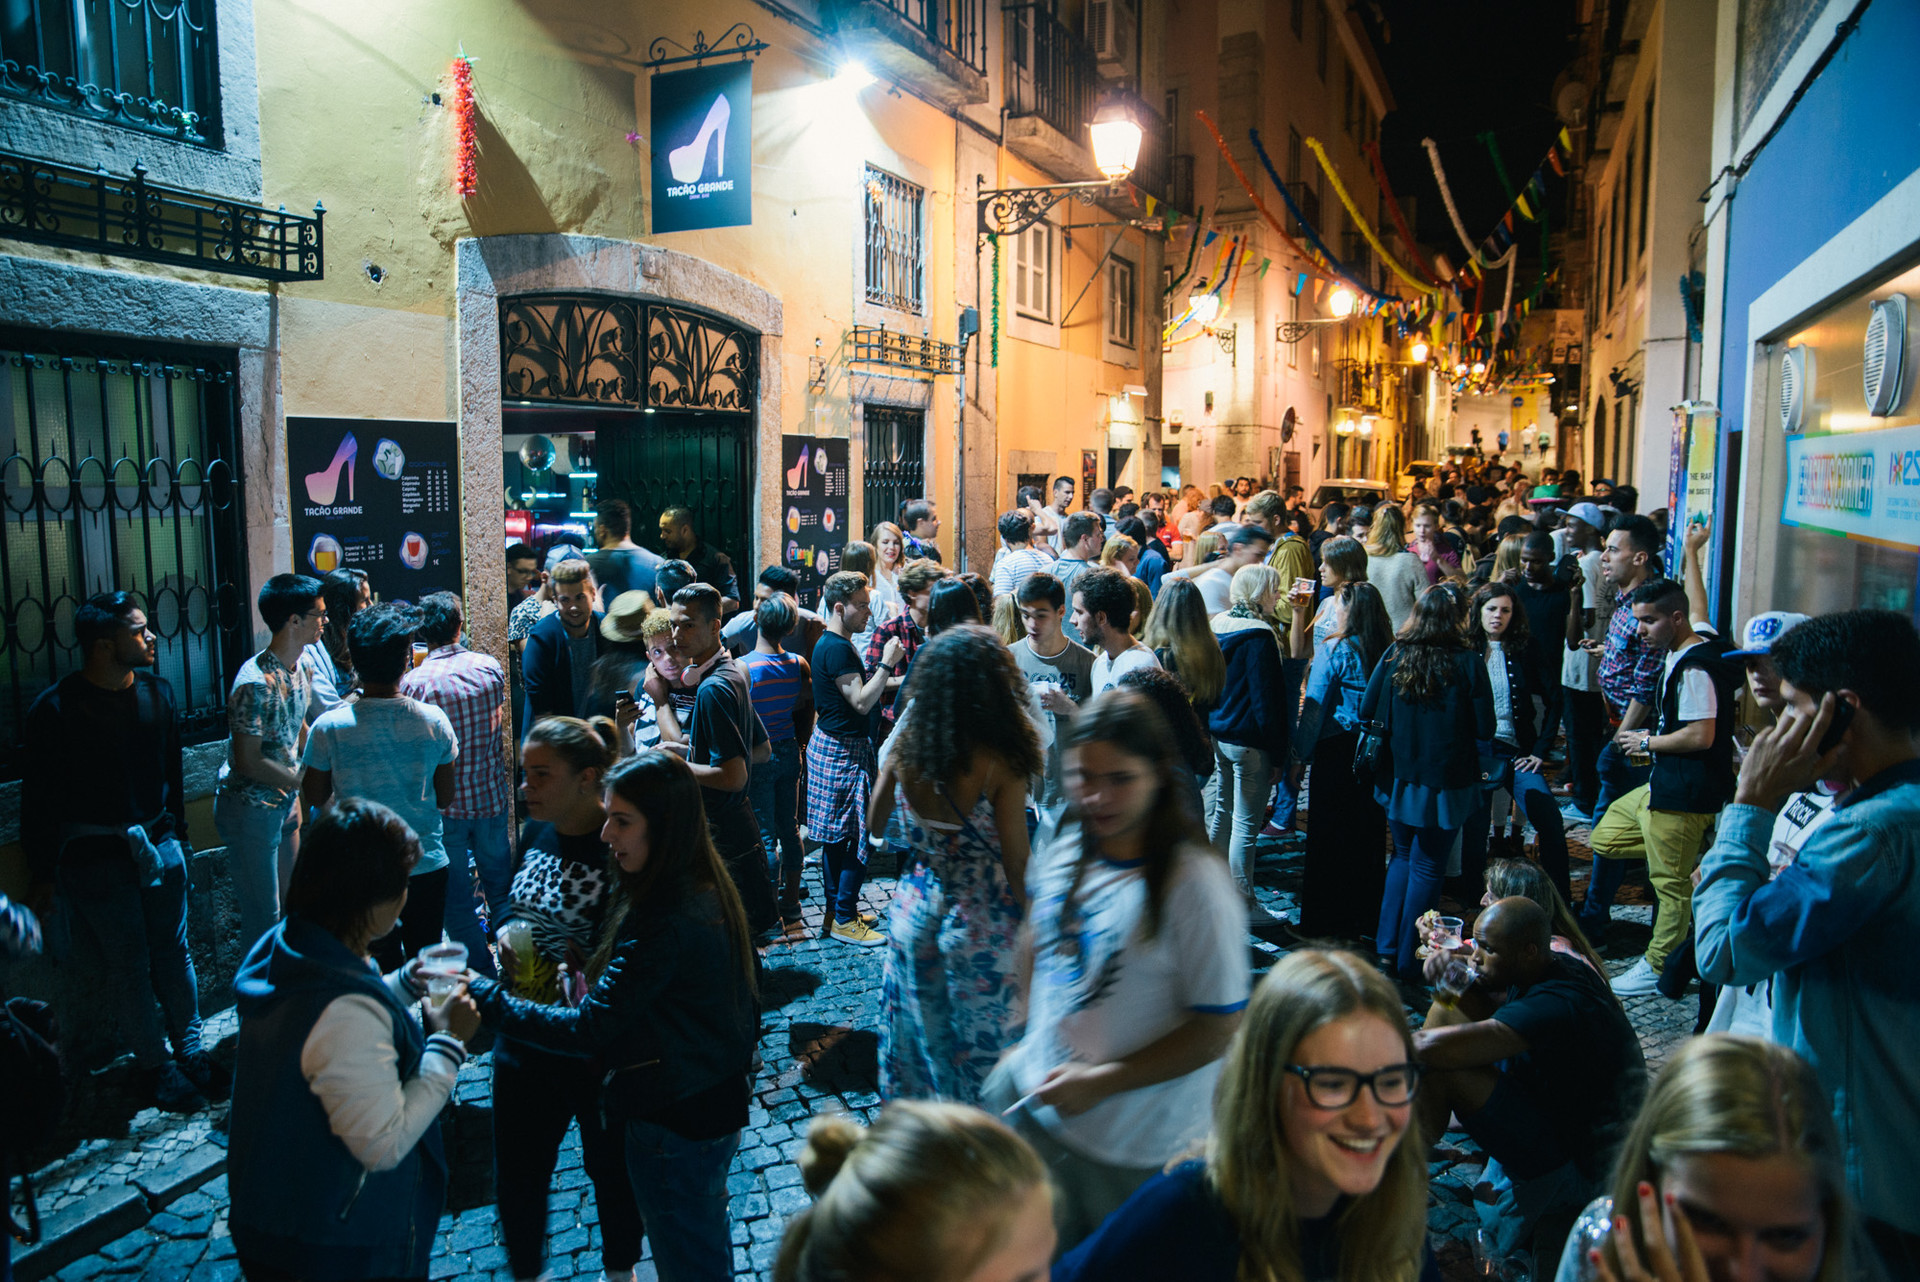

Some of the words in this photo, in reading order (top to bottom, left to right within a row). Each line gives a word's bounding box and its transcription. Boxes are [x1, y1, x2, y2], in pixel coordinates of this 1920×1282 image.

[666, 183, 697, 198] TACÃO
[697, 179, 734, 194] GRANDE
[1798, 453, 1835, 510] ERASMUS
[1835, 451, 1875, 516] CORNER
[304, 505, 331, 516] TACÃO
[332, 506, 363, 515] GRANDE
[432, 558, 440, 566] 1€
[1787, 799, 1816, 826] ROCK
